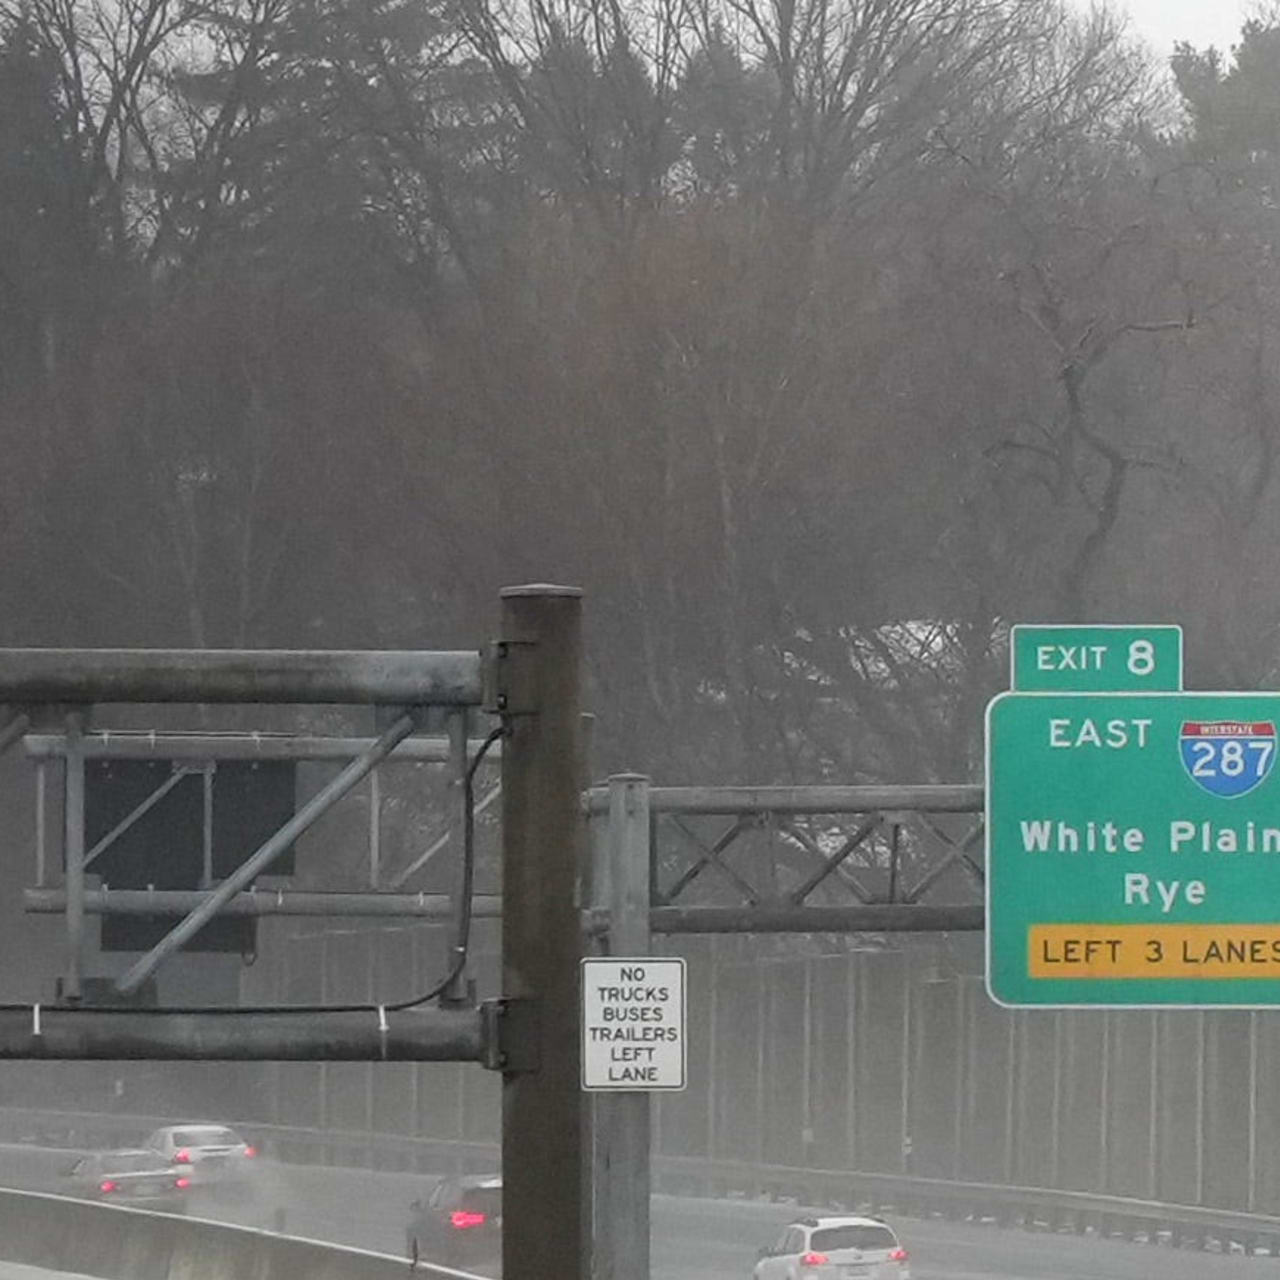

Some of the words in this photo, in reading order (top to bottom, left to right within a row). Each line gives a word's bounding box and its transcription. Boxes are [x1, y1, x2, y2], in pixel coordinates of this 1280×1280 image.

[1036, 646, 1108, 671] EXIT
[1126, 640, 1156, 676] 8
[1049, 719, 1153, 749] EAST
[1192, 741, 1273, 777] 287
[1020, 821, 1145, 853] White
[1123, 873, 1206, 913] Rye
[1042, 940, 1123, 964] LEFT
[1145, 940, 1164, 964] 3
[620, 967, 646, 981] NO
[598, 987, 669, 1002] TRUCKS
[603, 1007, 664, 1021] BUSES
[589, 1027, 678, 1041] TRAILERS
[611, 1047, 656, 1061] LEFT
[608, 1067, 659, 1081] LANE
